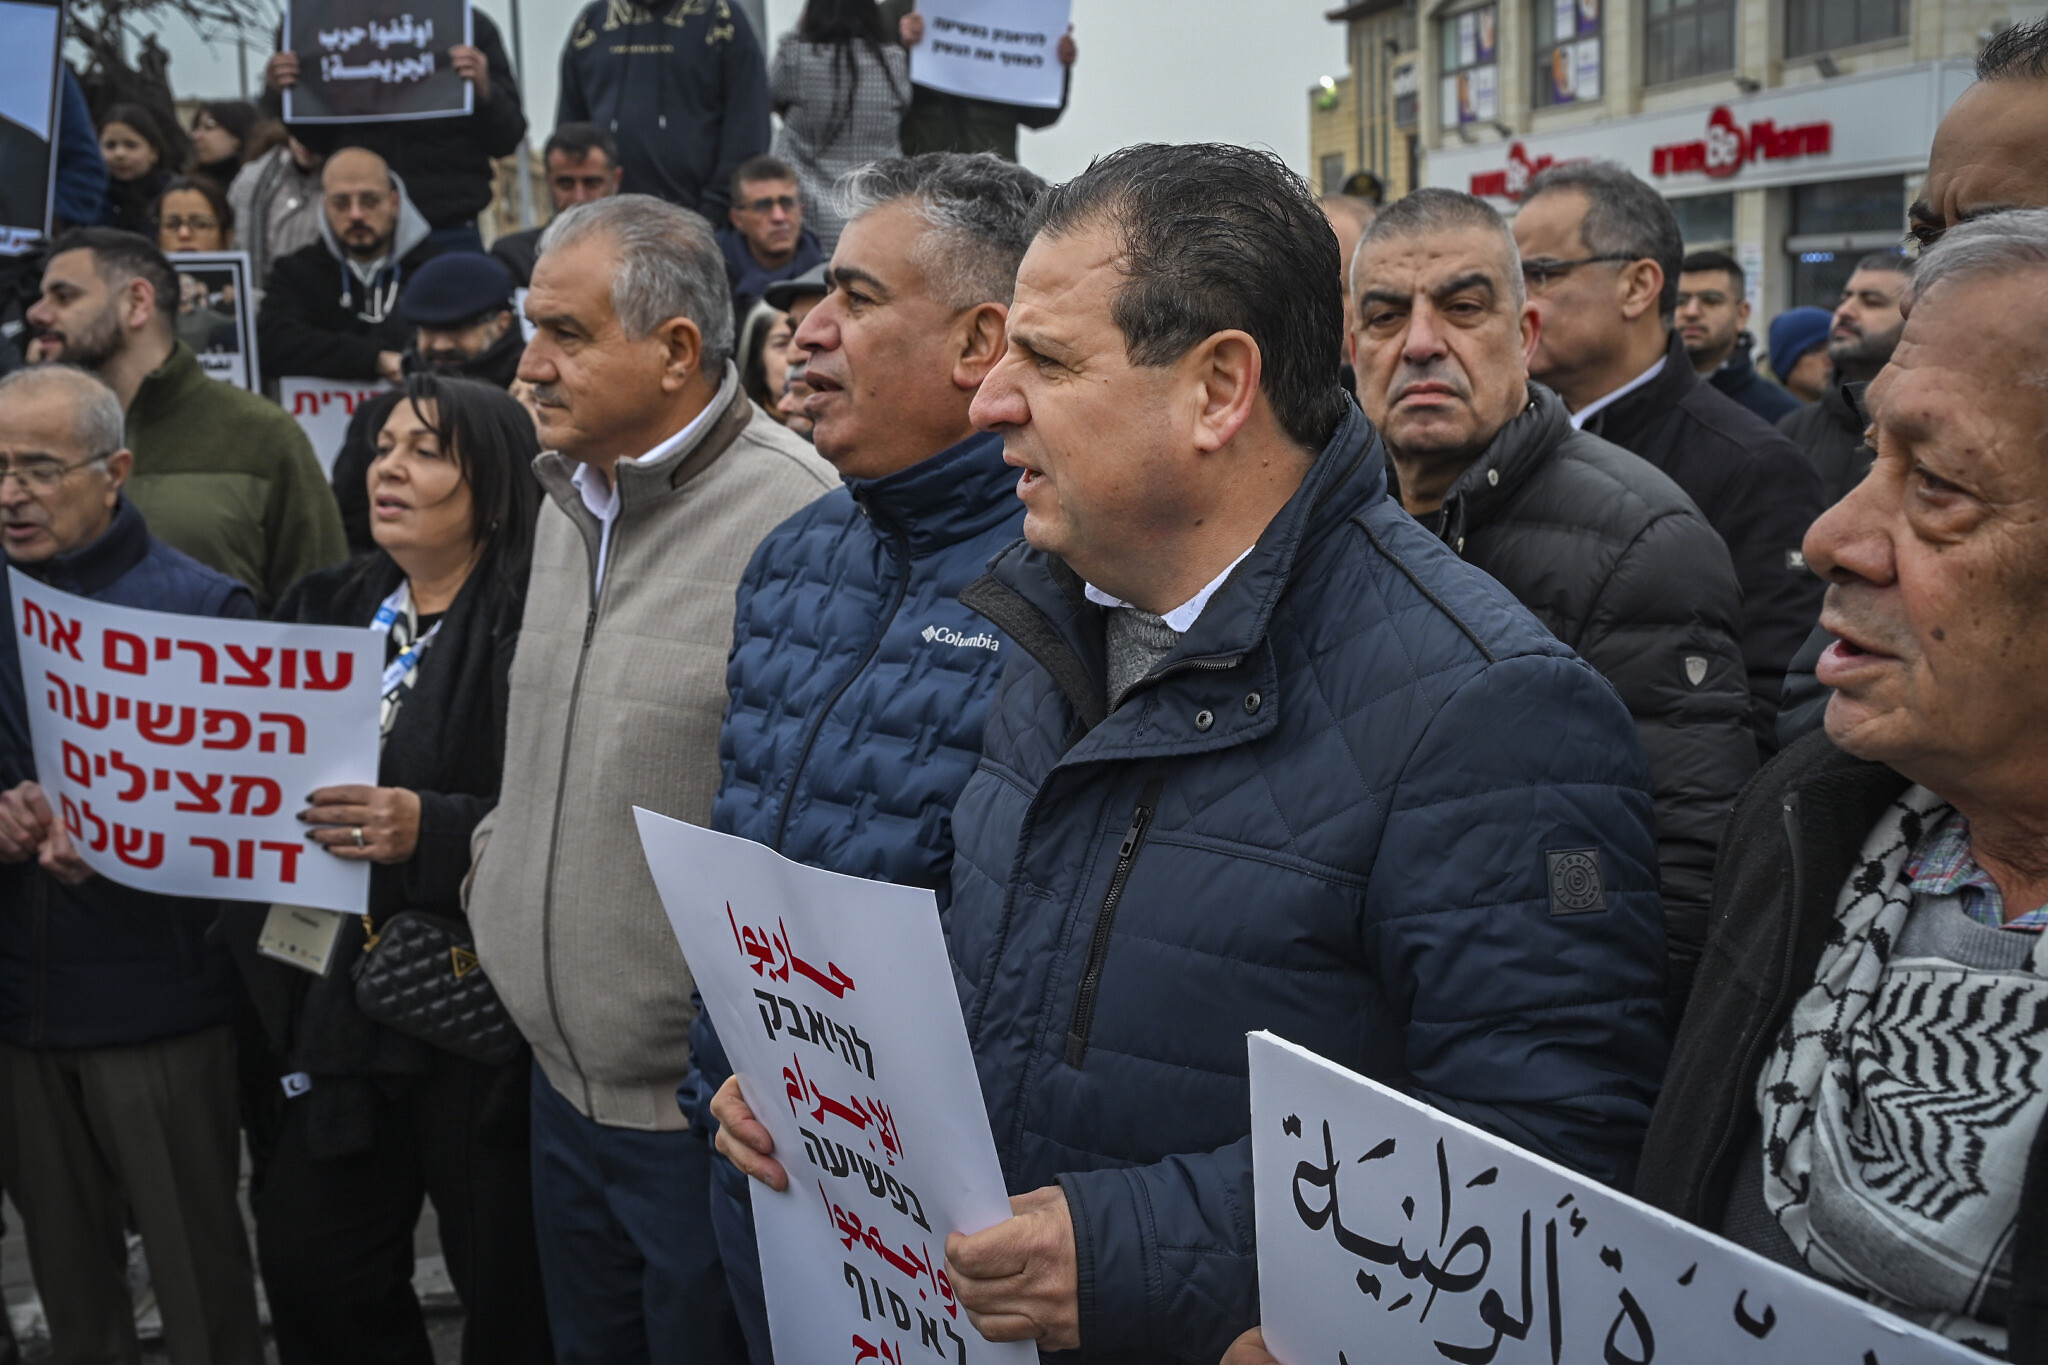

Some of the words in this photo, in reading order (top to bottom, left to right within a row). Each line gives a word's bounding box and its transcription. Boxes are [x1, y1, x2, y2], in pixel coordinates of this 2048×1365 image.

[318, 26, 367, 52] حرب
[23, 597, 84, 663] את
[103, 629, 354, 692] עוצרים
[935, 626, 1000, 652] Columbia
[46, 670, 307, 755] הפשיעה
[62, 739, 283, 817] מצילים
[60, 792, 165, 871] שלם
[189, 836, 304, 884] דור
[726, 900, 856, 999] حاربوا
[753, 987, 875, 1082] להיאבק
[799, 1126, 933, 1234] בפשיעה
[817, 1178, 957, 1321] واجمعوا
[844, 1261, 967, 1365] לאסוף
